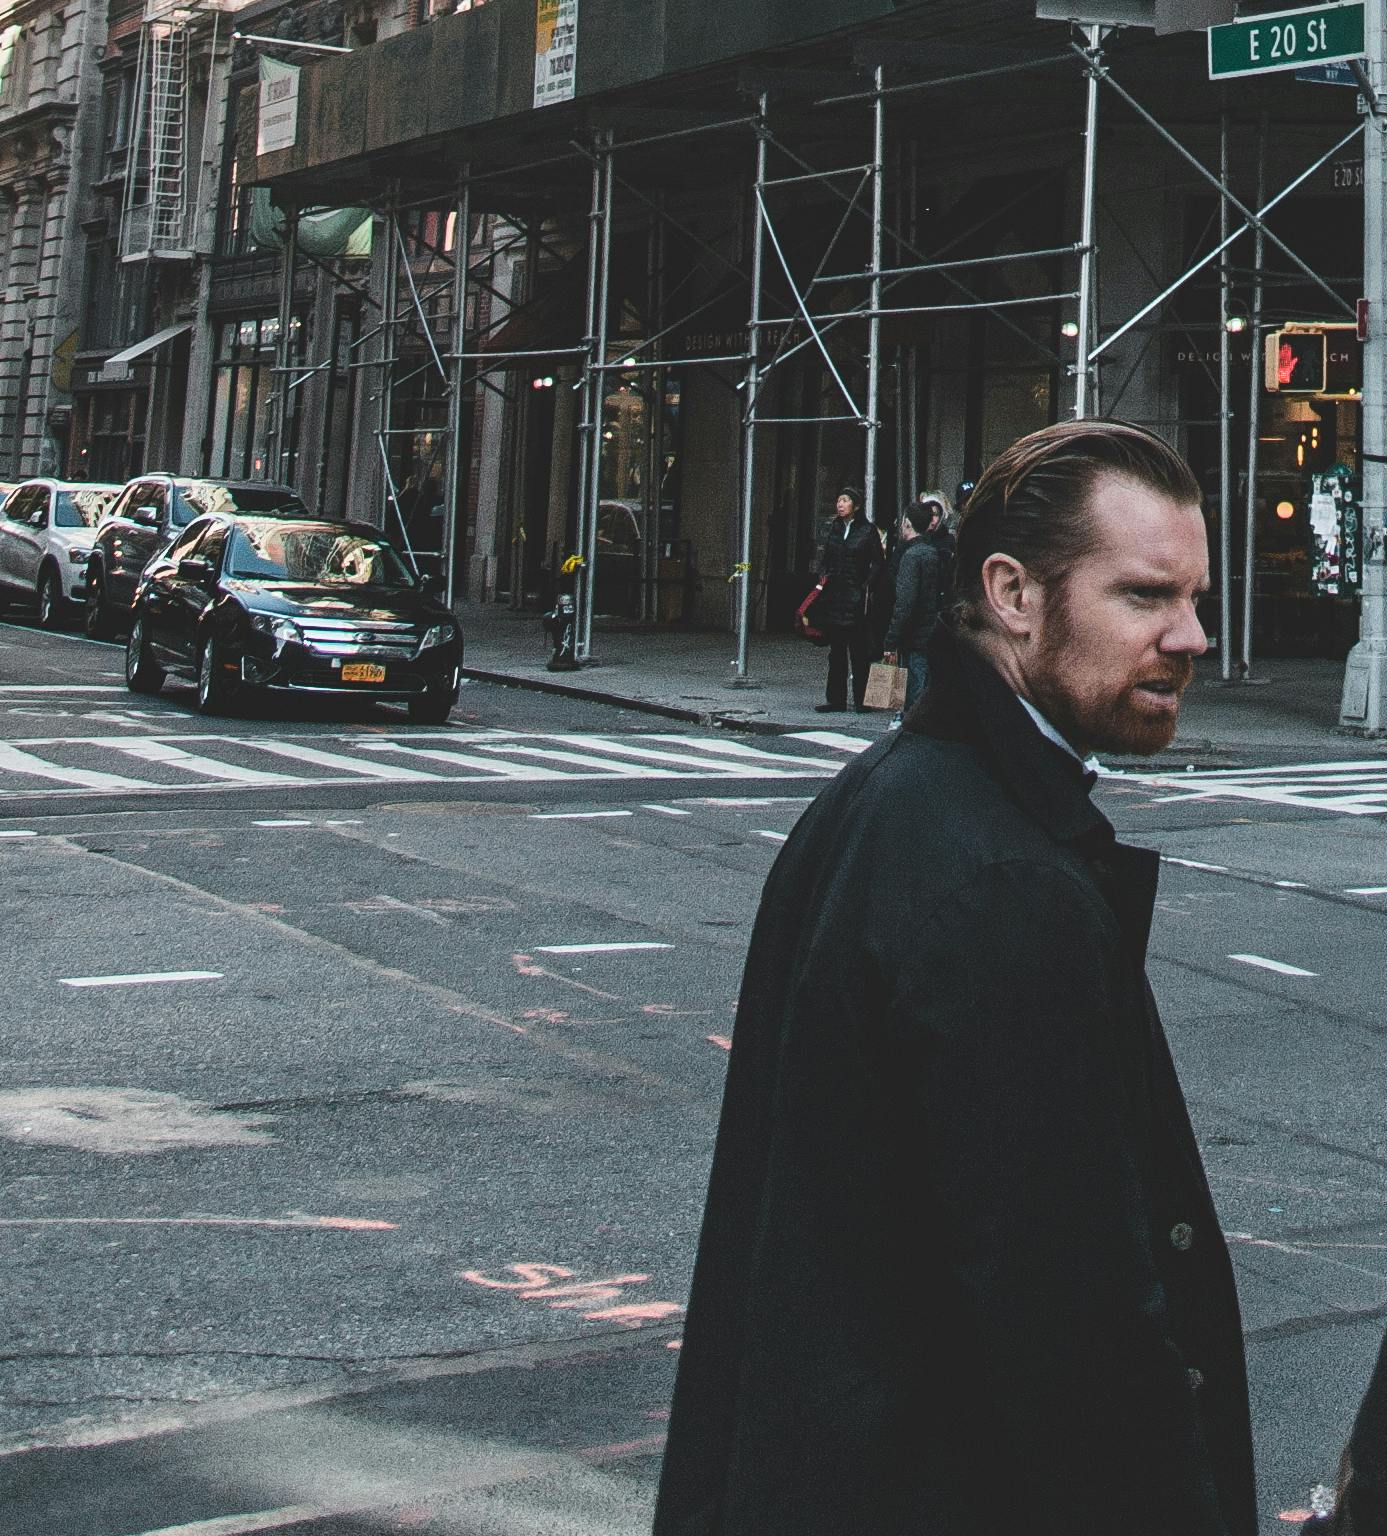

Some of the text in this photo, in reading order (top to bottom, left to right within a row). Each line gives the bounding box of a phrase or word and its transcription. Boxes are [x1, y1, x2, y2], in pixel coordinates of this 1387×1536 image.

[1250, 18, 1327, 61] E 20 St
[1341, 167, 1353, 187] 20
